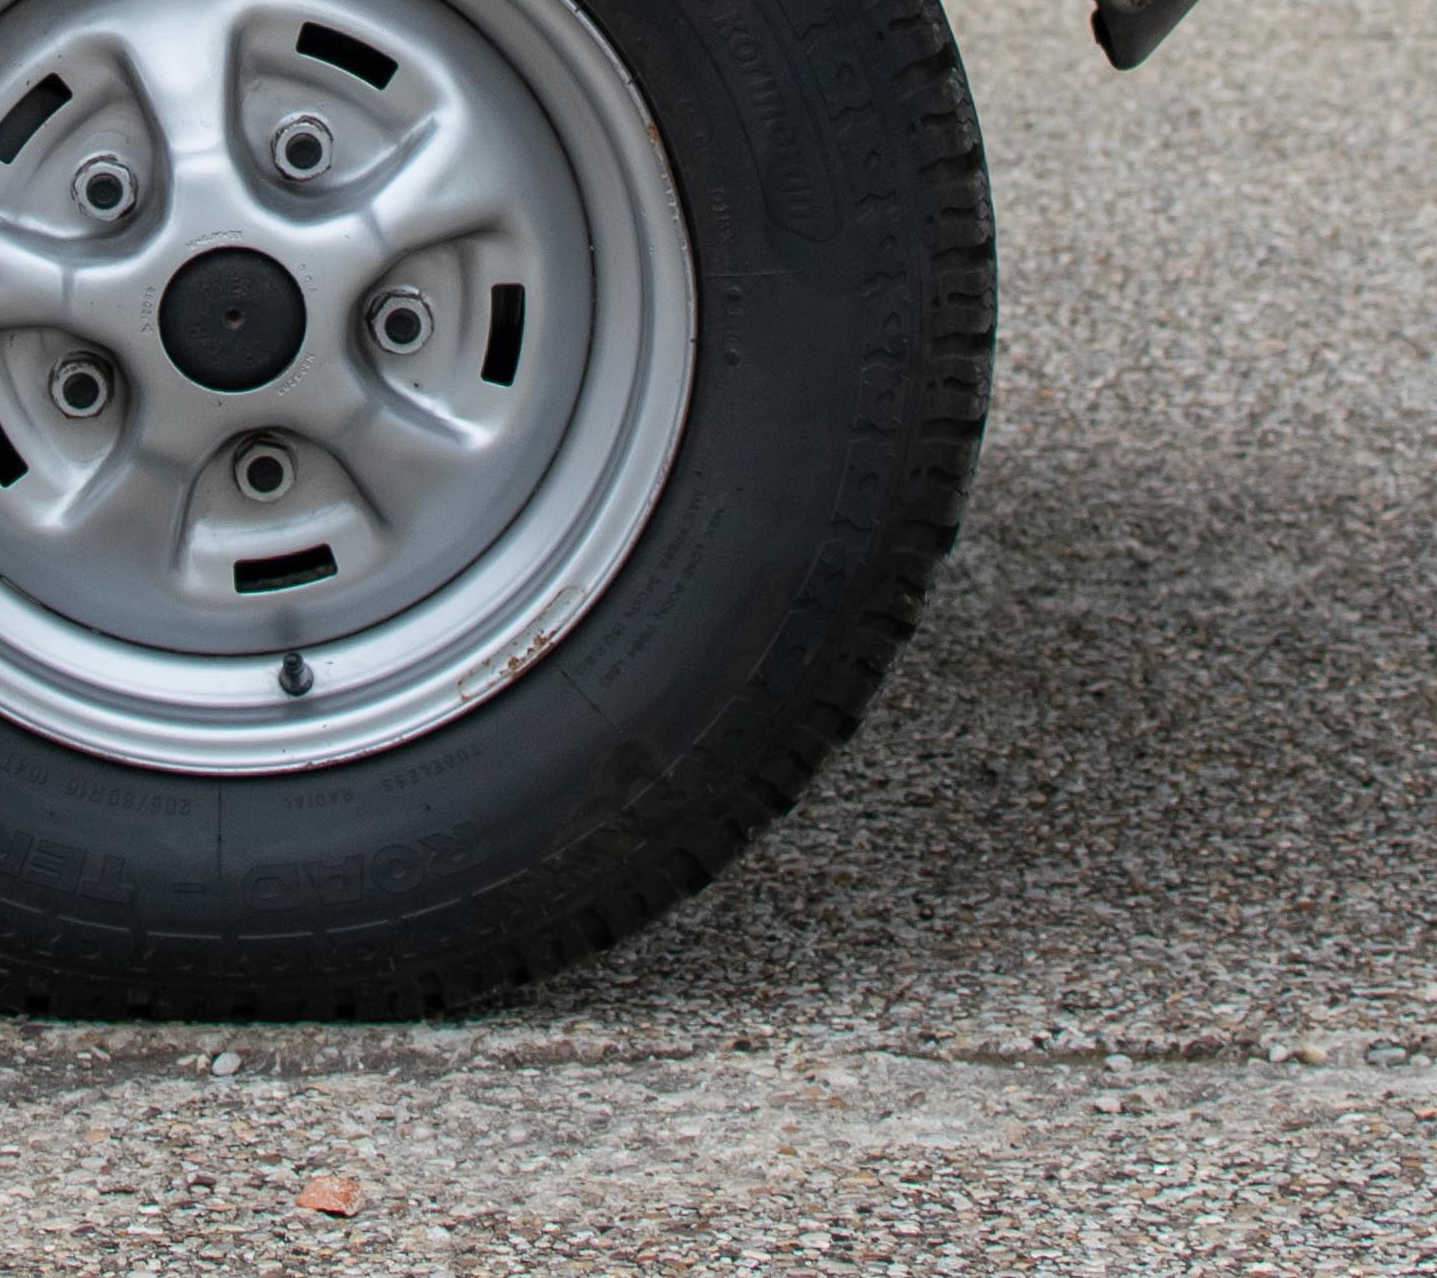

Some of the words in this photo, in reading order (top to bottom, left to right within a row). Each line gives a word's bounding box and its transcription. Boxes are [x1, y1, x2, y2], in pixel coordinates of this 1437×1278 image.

[380, 737, 484, 795] TUBELESS
[283, 784, 357, 814] RADIAL
[244, 818, 488, 914] ROAD
